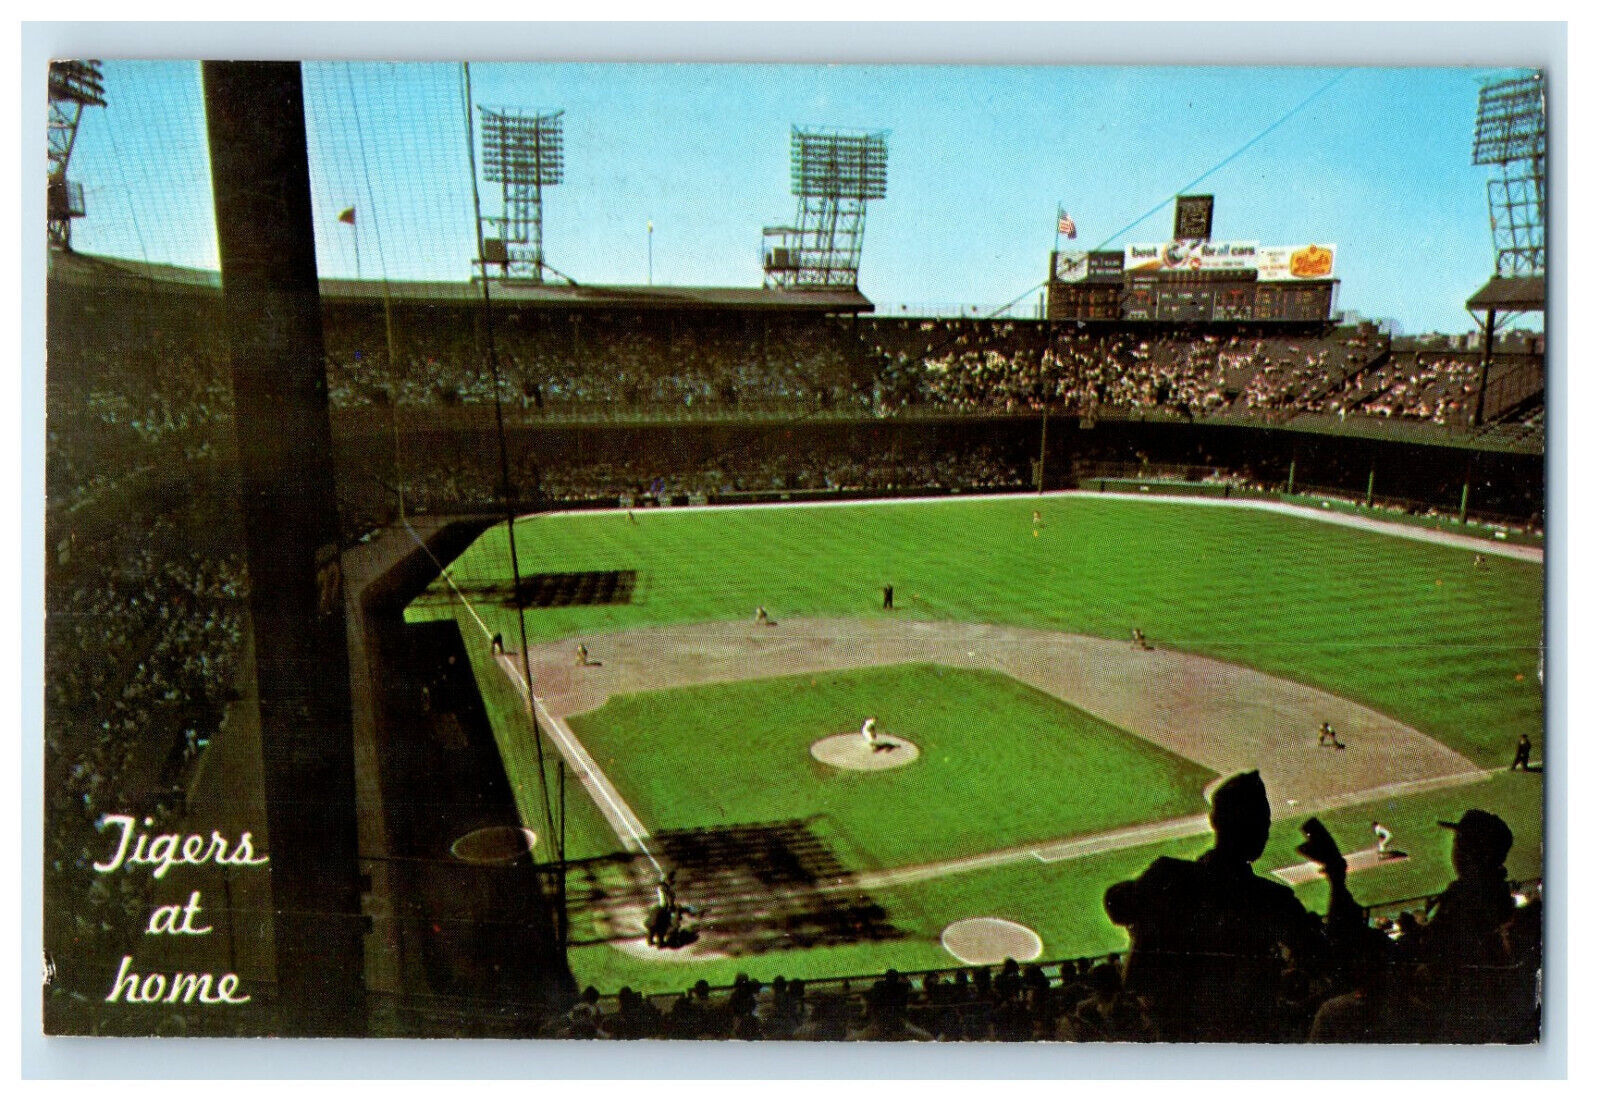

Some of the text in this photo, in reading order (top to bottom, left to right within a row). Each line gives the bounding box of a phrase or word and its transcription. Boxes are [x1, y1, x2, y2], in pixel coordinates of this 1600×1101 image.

[1131, 246, 1157, 257] best
[1201, 244, 1215, 256] for
[1217, 244, 1230, 255] all
[1231, 246, 1255, 256] cars
